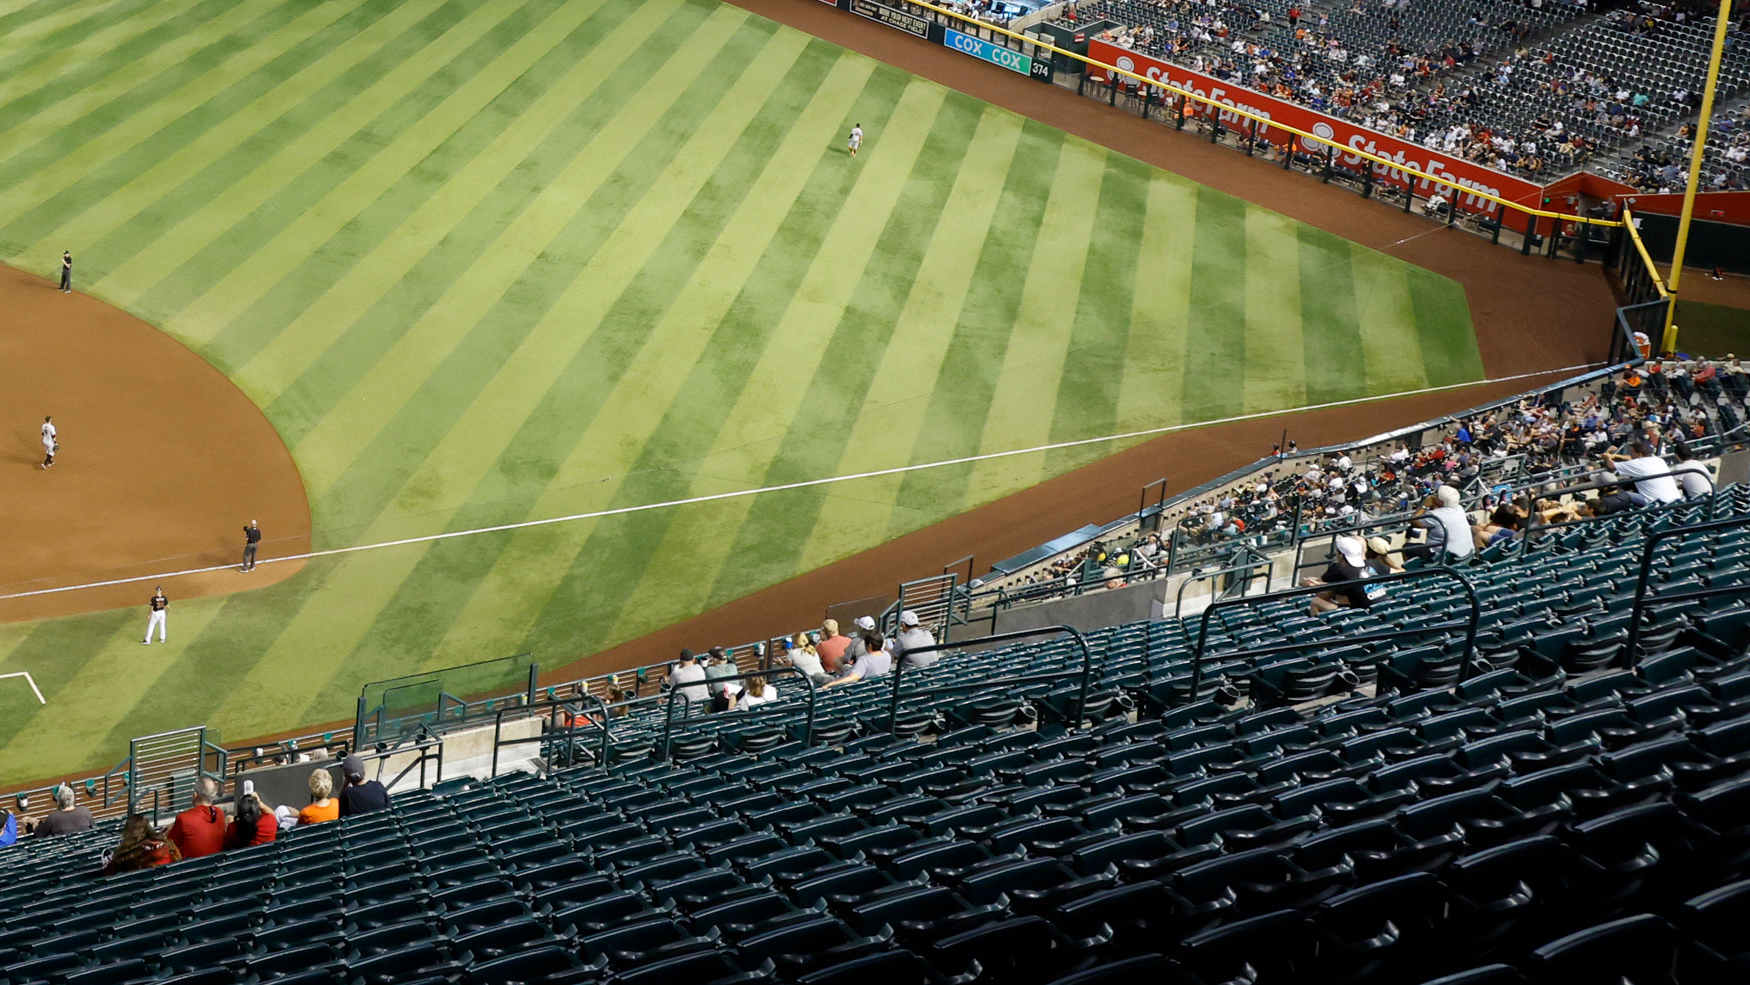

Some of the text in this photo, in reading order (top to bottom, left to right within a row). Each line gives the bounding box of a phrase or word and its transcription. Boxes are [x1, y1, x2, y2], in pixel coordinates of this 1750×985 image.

[955, 35, 1021, 69] COX COX
[1032, 62, 1048, 77] 374
